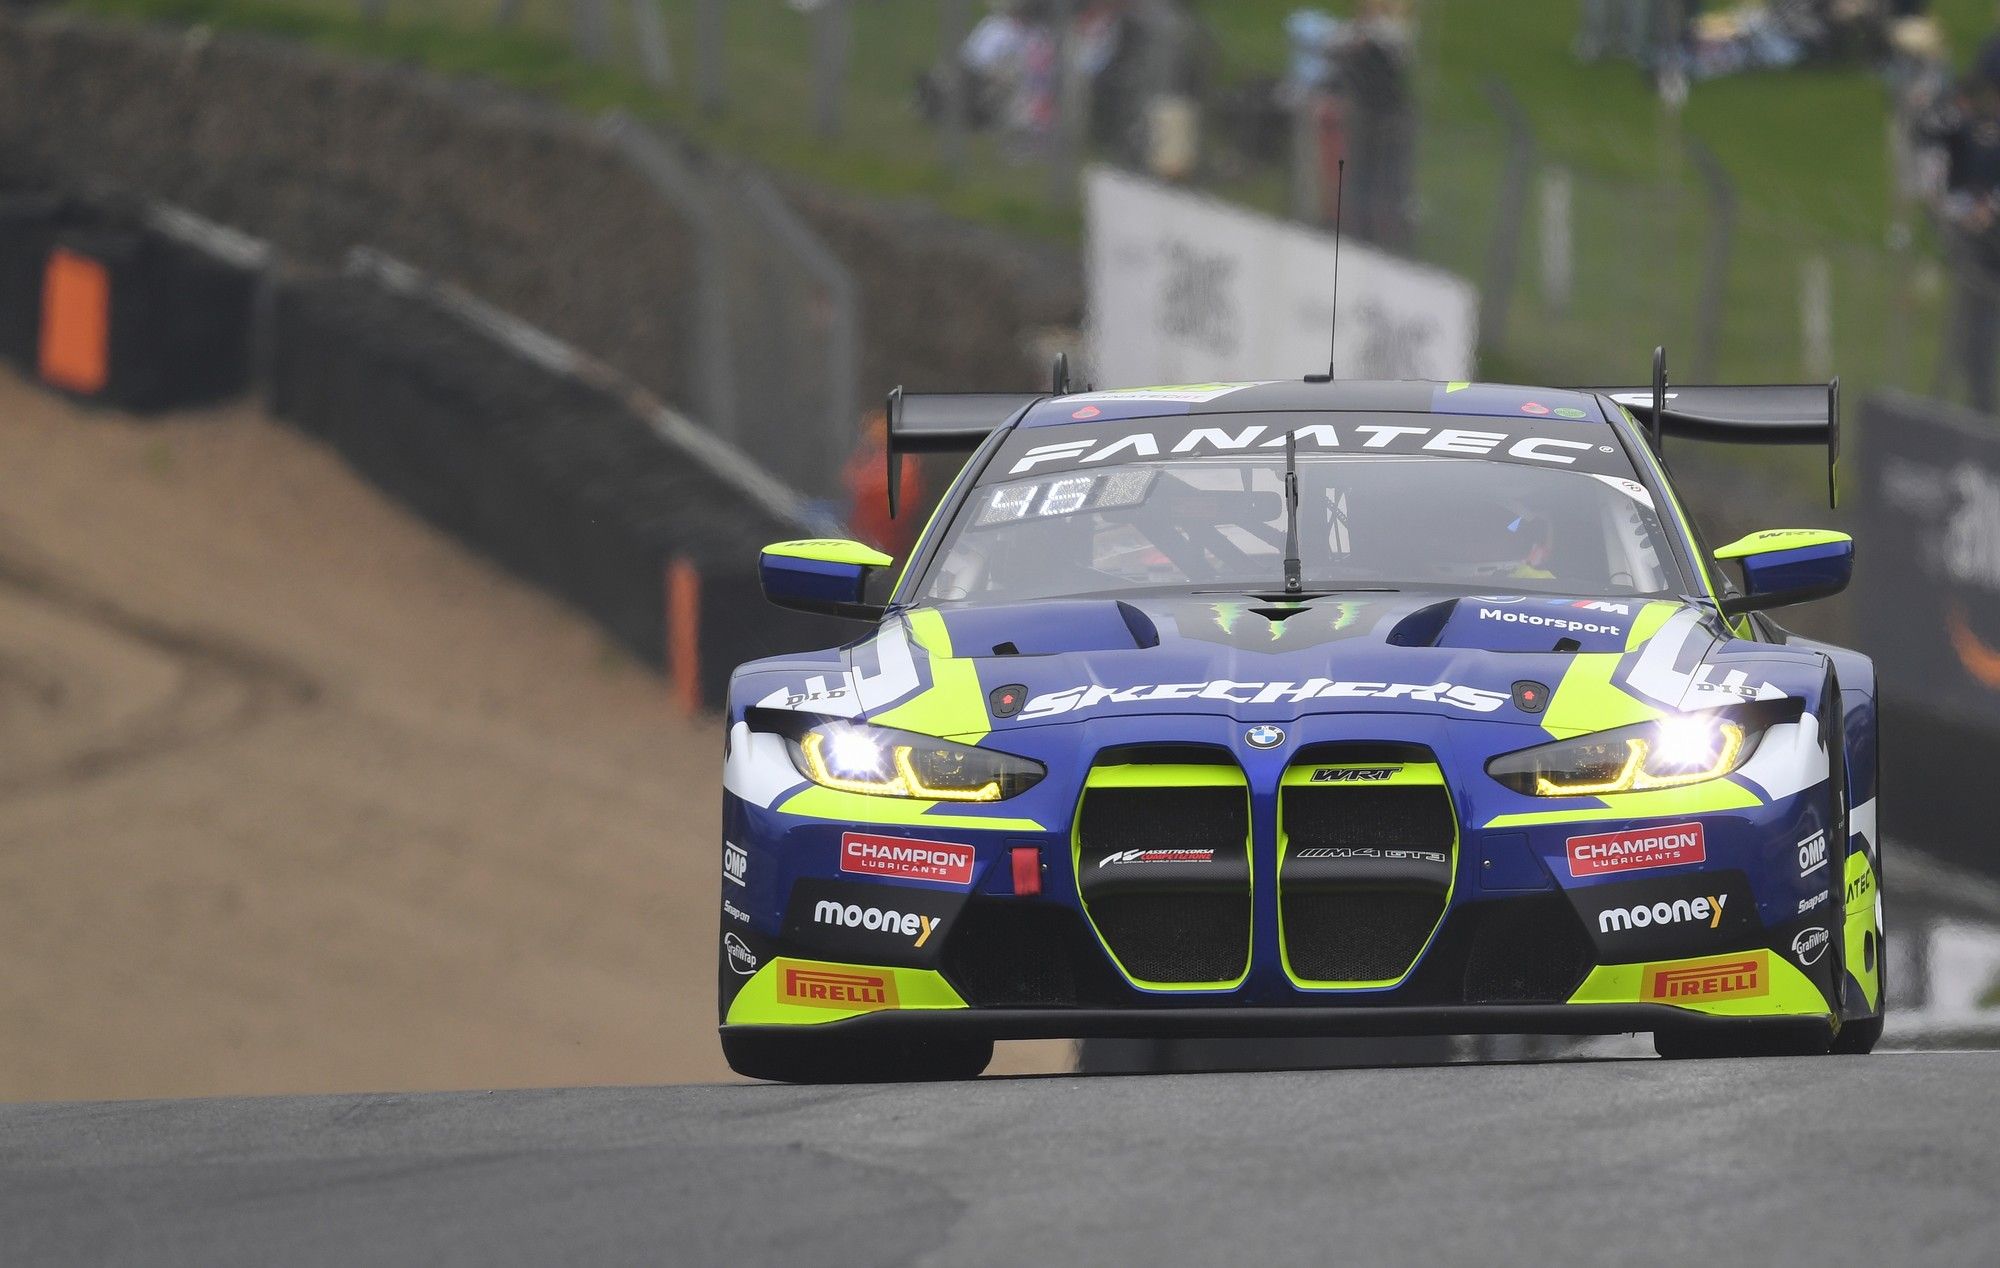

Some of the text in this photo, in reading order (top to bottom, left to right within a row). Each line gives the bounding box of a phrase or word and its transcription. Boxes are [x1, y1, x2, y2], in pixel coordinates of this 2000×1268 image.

[1008, 424, 1594, 475] FANATEC
[1479, 608, 1621, 636] Motorsport
[1016, 678, 1512, 722] SKECHERS
[1310, 767, 1404, 782] WRT
[847, 842, 968, 868] CHAMPION
[1385, 849, 1446, 863] GT3
[1574, 833, 1698, 861] CHAMPION
[1593, 850, 1682, 868] LUBRICANTS
[1798, 836, 1826, 869] OMP
[724, 848, 747, 880] OMP
[861, 859, 948, 876] LUBRICANTS
[1797, 889, 1829, 914] Snap-on
[1846, 868, 1871, 904] ATEC
[814, 900, 942, 948] mooney
[1598, 894, 1727, 933] mooney
[786, 968, 885, 1004] PIRELLI
[1653, 960, 1758, 998] PIRELLI
